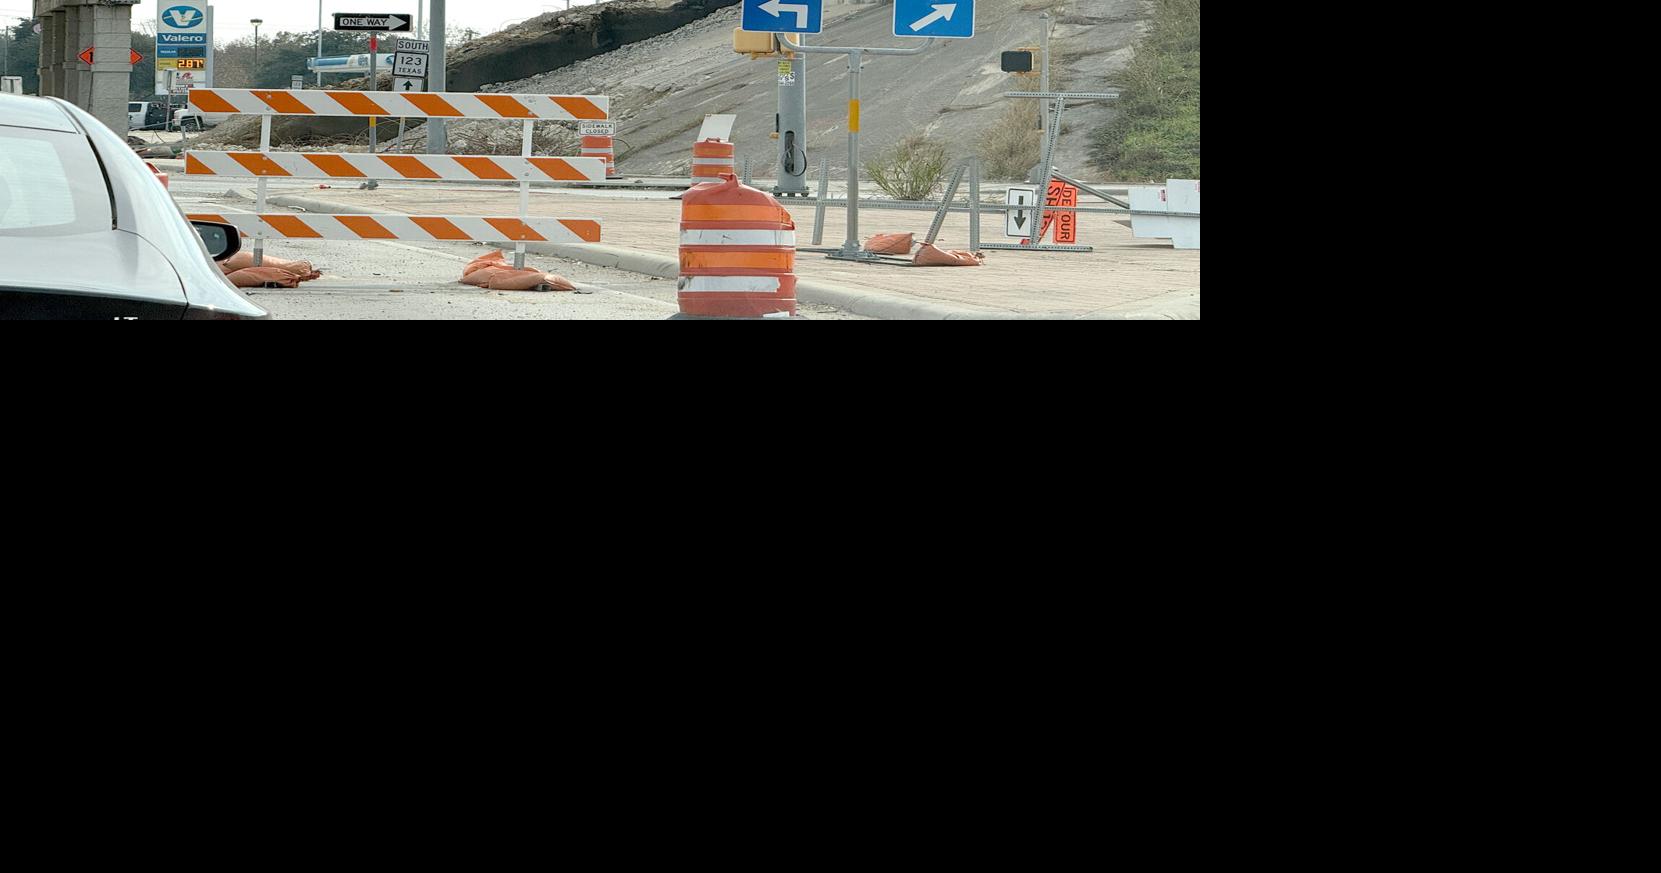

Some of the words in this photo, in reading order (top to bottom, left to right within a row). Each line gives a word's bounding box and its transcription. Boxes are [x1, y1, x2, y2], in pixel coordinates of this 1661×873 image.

[342, 18, 363, 26] ONE
[366, 18, 387, 26] WAY
[162, 34, 203, 42] Valero
[398, 41, 428, 50] SOUTH
[400, 56, 422, 66] 123
[1060, 190, 1072, 240] DEOUR
